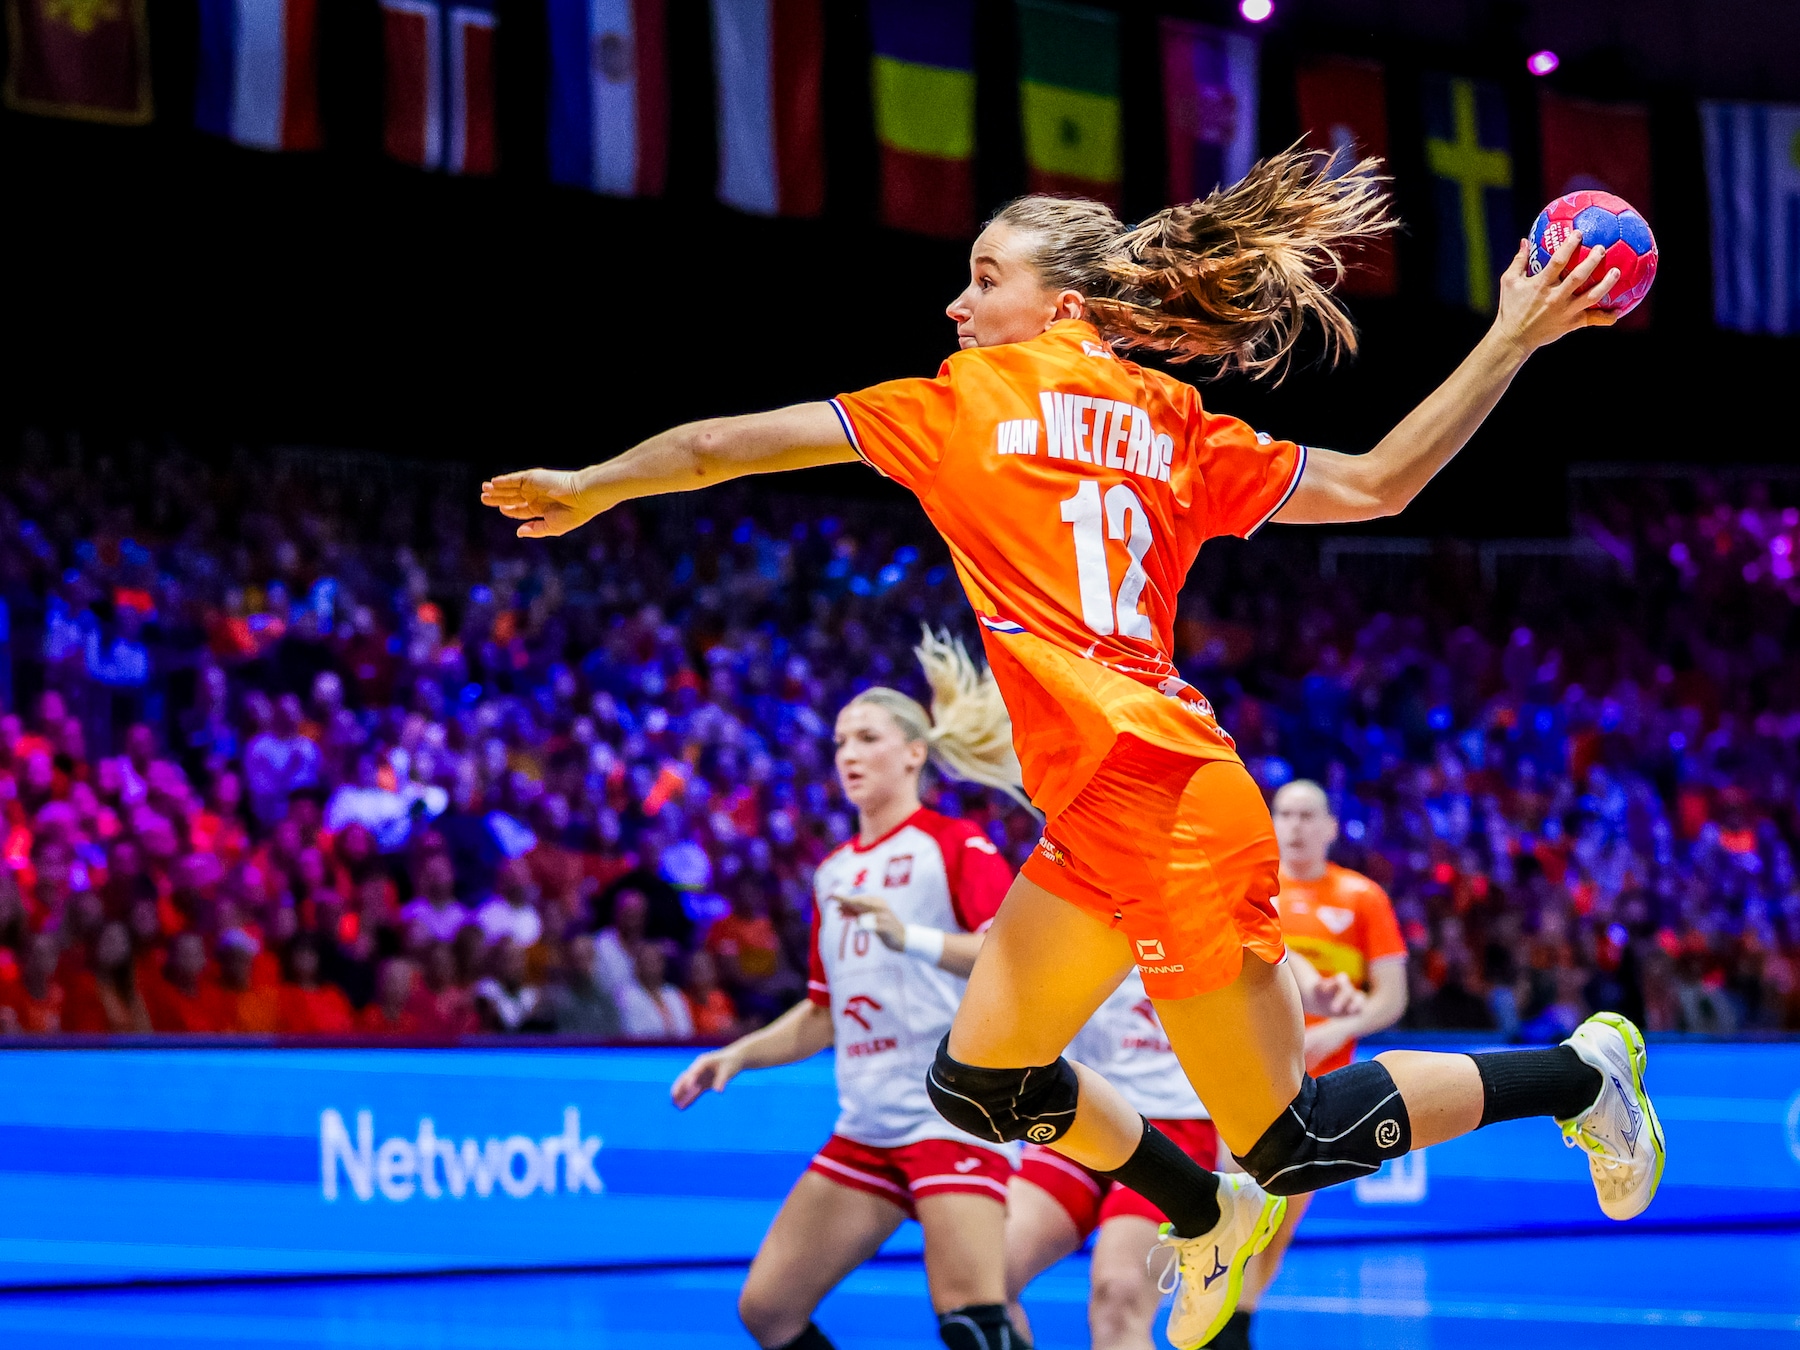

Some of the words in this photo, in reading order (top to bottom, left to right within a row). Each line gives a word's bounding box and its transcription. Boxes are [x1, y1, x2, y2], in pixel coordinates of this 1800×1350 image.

[997, 419, 1038, 455] VAN
[1060, 480, 1153, 641] 12
[320, 1104, 605, 1201] Network
